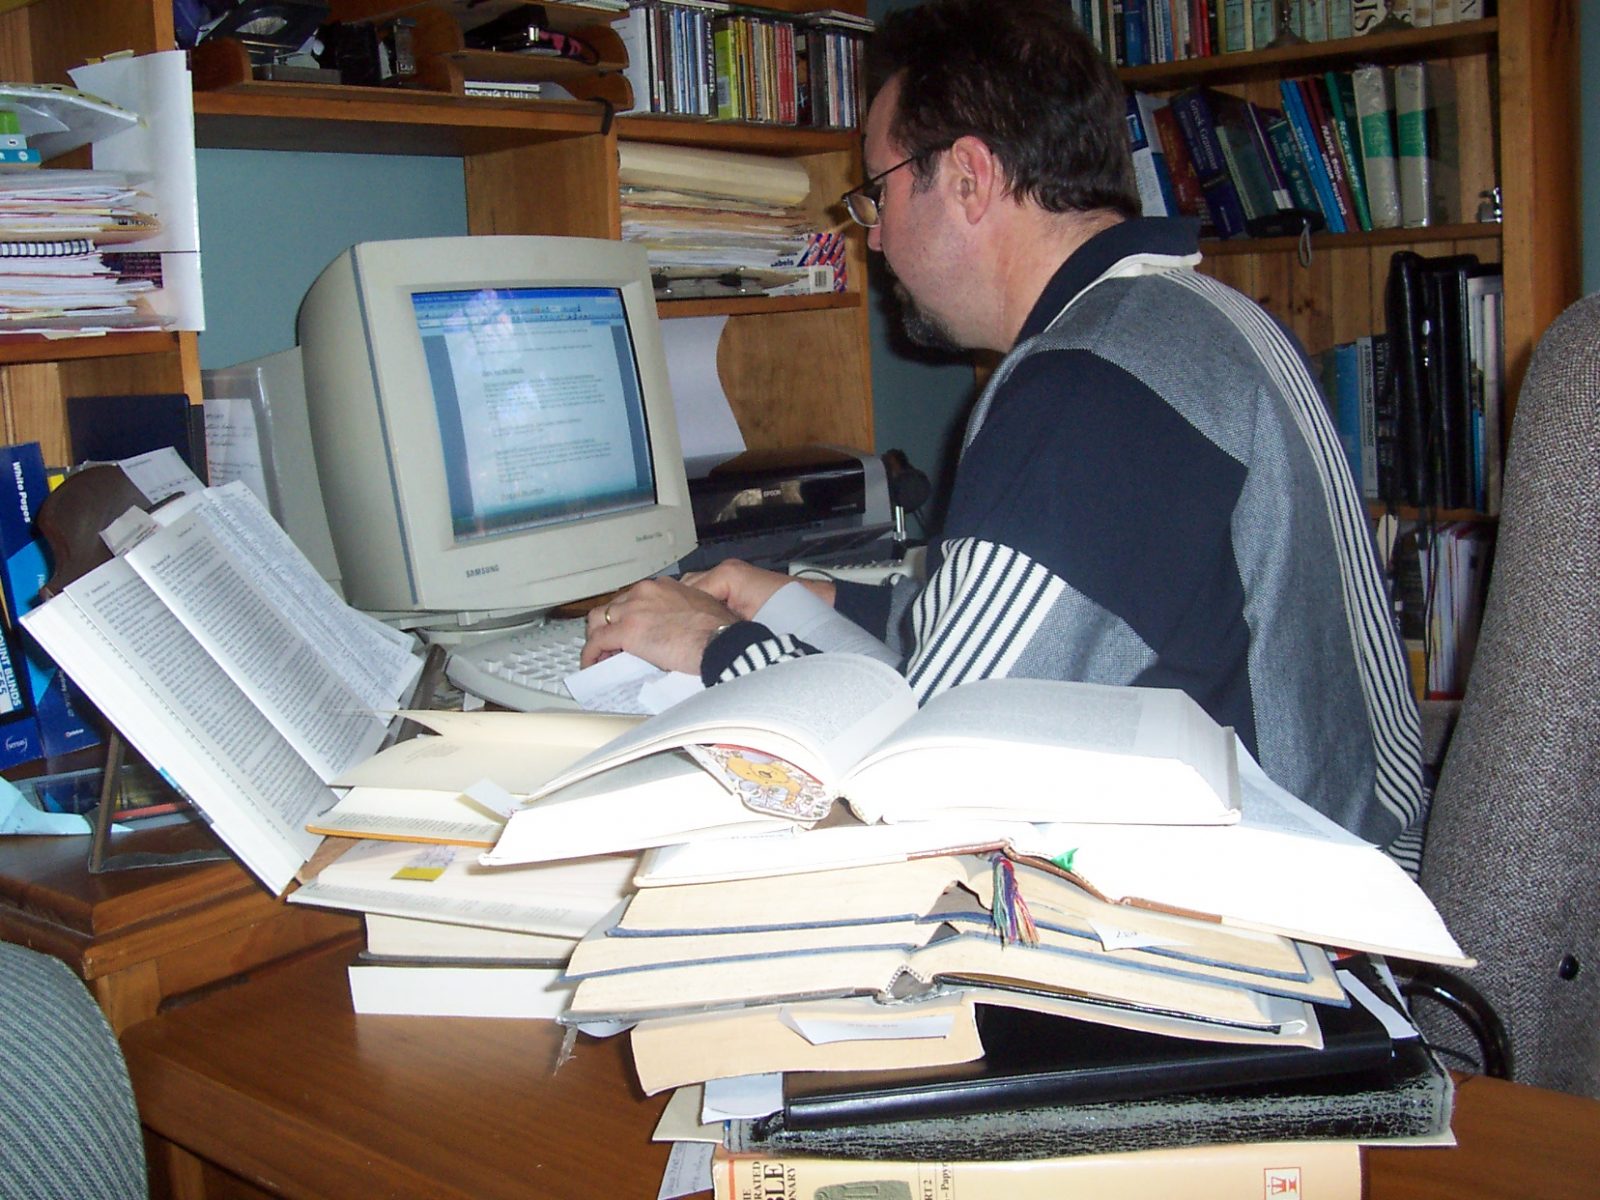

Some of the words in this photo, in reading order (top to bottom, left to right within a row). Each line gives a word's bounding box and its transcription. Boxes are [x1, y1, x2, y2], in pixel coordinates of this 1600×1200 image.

[1353, 0, 1378, 32] IS
[12, 461, 24, 491] White
[18, 491, 31, 523] Pages
[763, 489, 782, 498] EPSON
[465, 563, 500, 578] SAMSUNG
[0, 629, 11, 666] OUNT
[4, 667, 22, 707] BLINDS
[752, 1161, 762, 1200] RATED
[763, 1163, 786, 1200] LE
